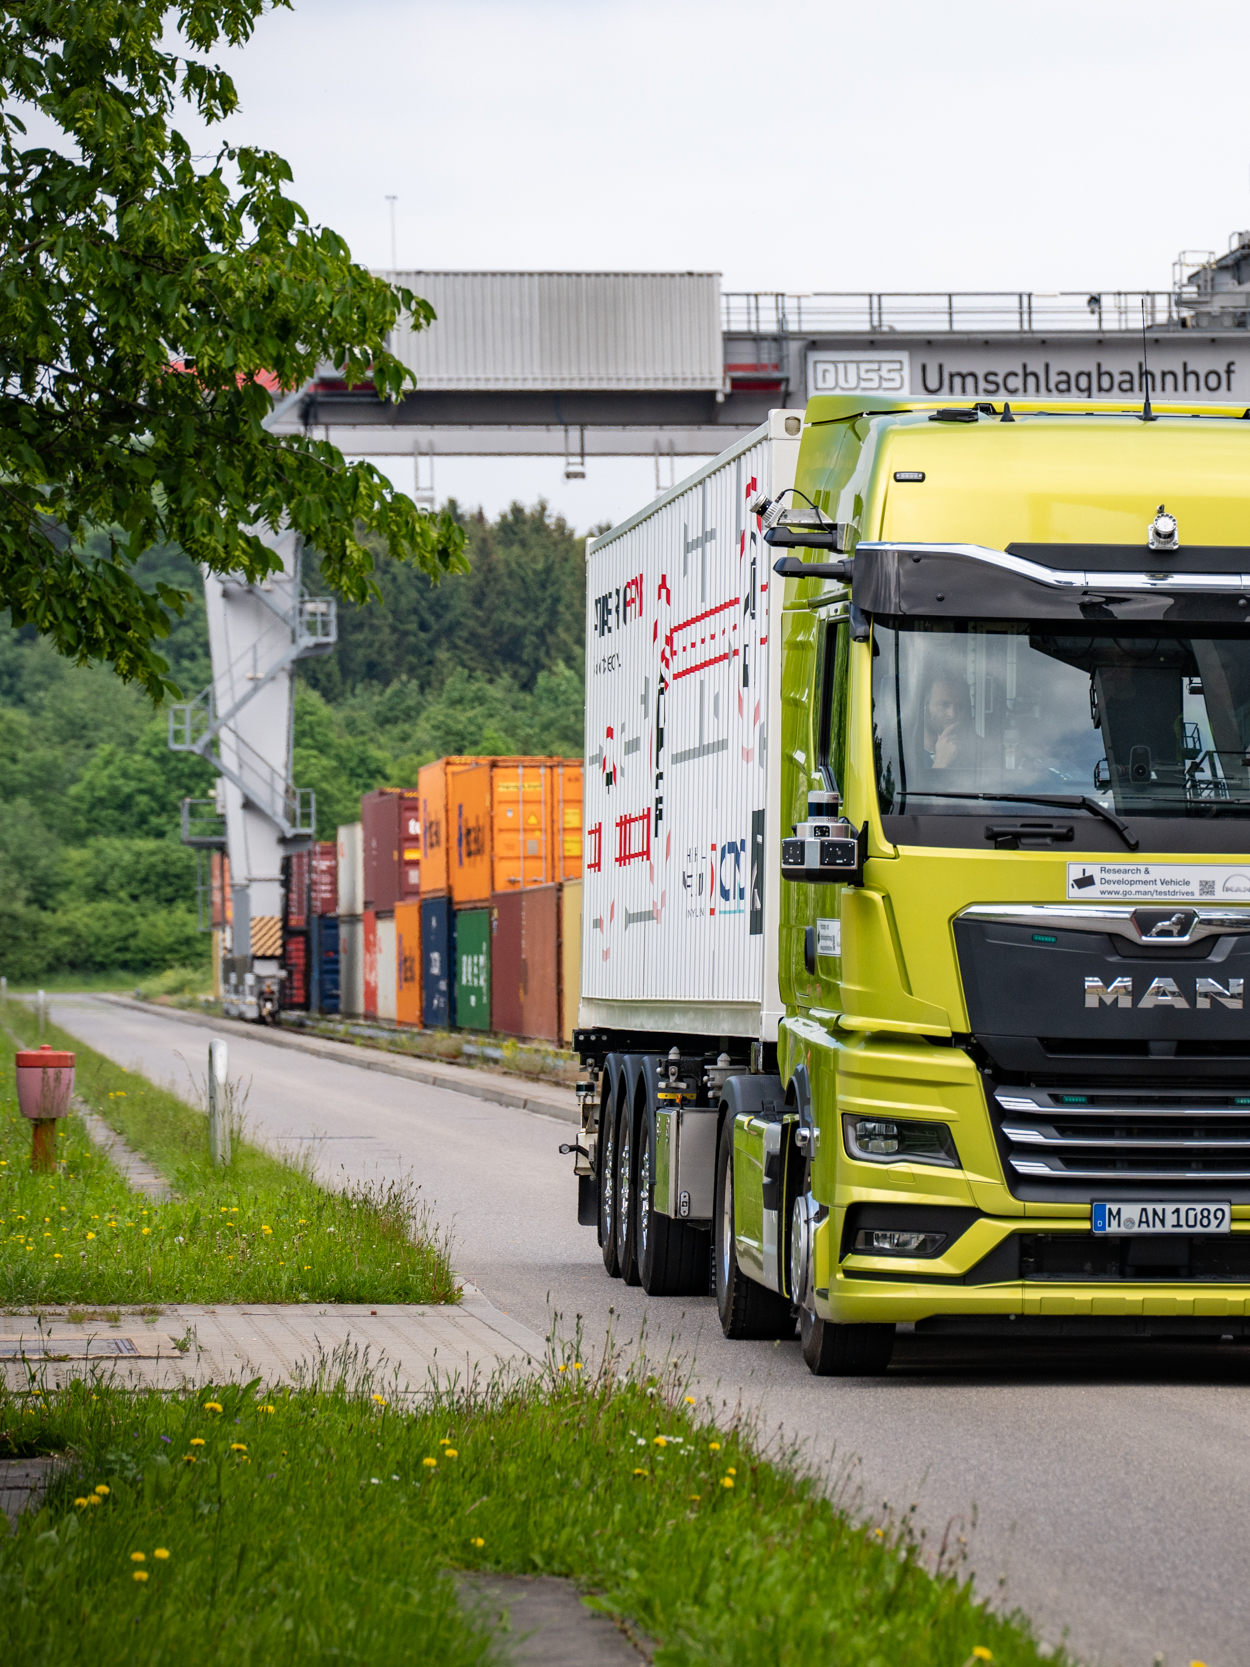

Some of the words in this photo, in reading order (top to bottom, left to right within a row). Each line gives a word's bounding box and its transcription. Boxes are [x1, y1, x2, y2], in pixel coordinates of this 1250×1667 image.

[813, 359, 904, 391] DUSS
[921, 361, 1235, 399] Umschlagbahnhof
[1100, 866, 1142, 875] Research
[1143, 867, 1150, 875] &
[1100, 877, 1157, 887] Development
[1159, 878, 1191, 886] Vehicle
[1099, 889, 1195, 897] www.go.man/testdrives
[1084, 976, 1245, 1010] MAN
[1171, 1207, 1226, 1229] 1089
